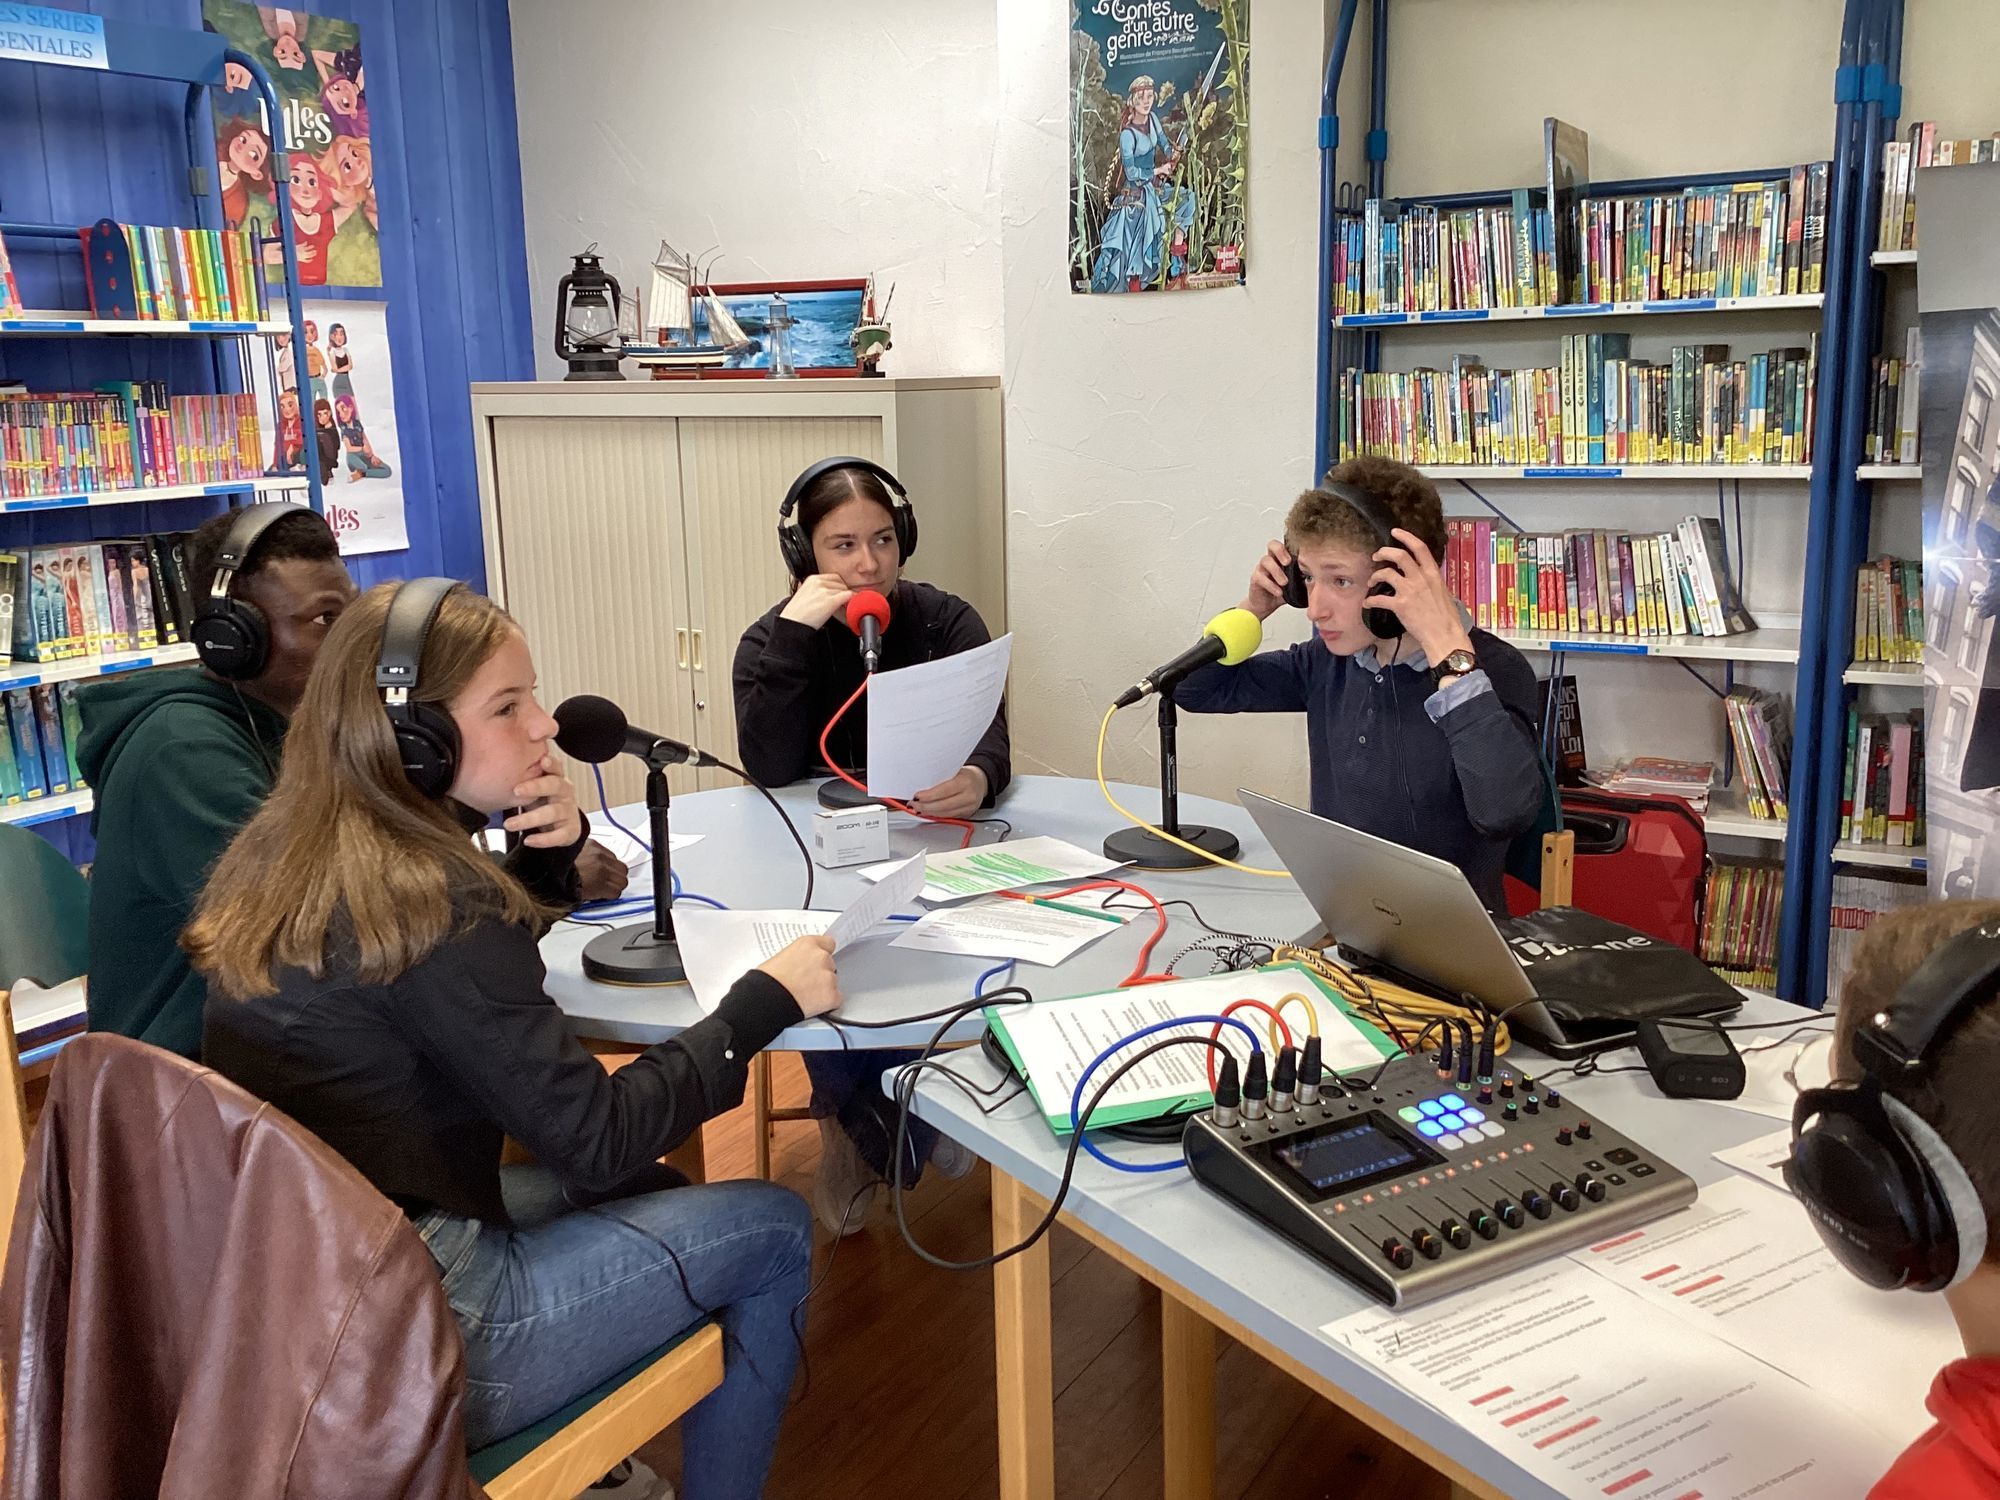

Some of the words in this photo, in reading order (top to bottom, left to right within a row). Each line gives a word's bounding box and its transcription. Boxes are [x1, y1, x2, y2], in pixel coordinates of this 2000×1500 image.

[1111, 0, 1171, 22] Contes
[1123, 20, 1148, 34] d'un
[1152, 11, 1199, 33] autre
[1107, 30, 1153, 67] genre
[1561, 737, 1582, 755] LOI
